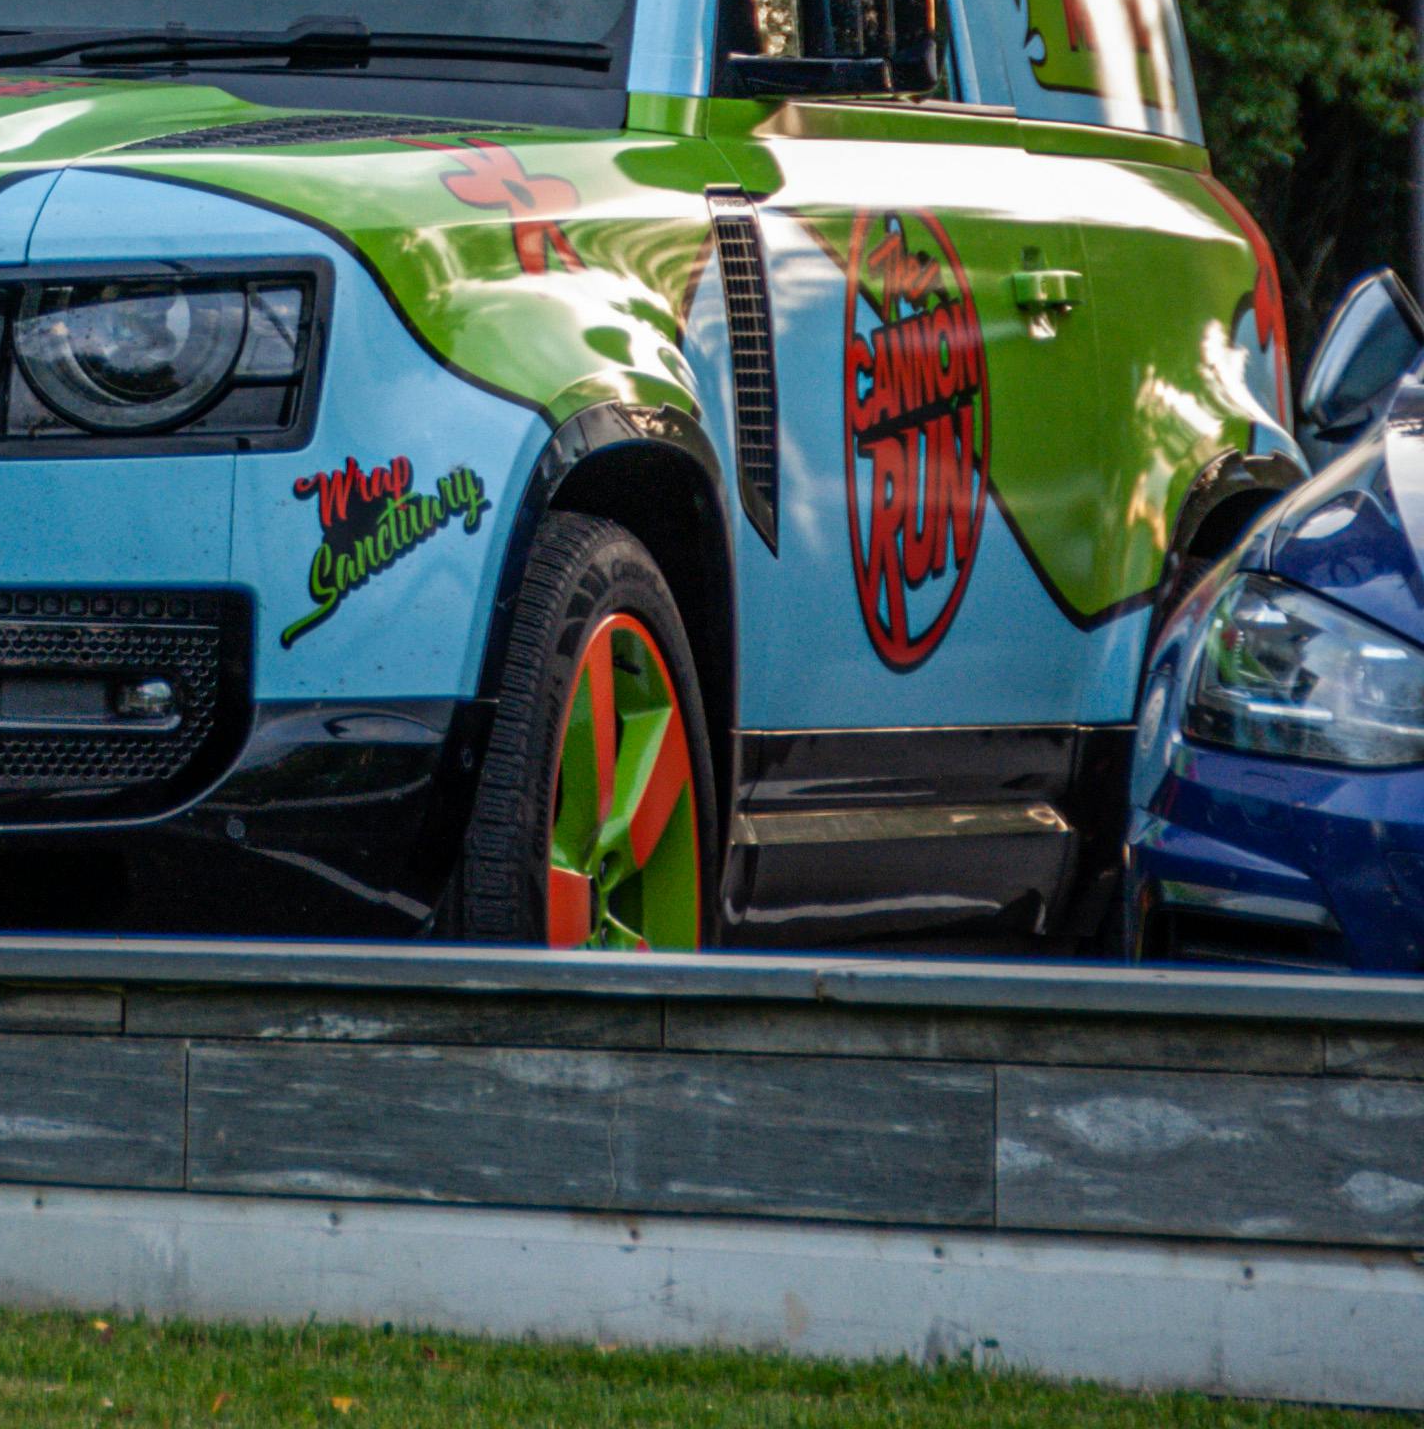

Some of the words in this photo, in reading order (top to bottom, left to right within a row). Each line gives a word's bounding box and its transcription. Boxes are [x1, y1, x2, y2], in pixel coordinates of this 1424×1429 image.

[849, 301, 979, 433] CANNON
[281, 466, 490, 649] Sanctuary
[294, 455, 413, 533] Wrap
[860, 403, 975, 644] RUN
